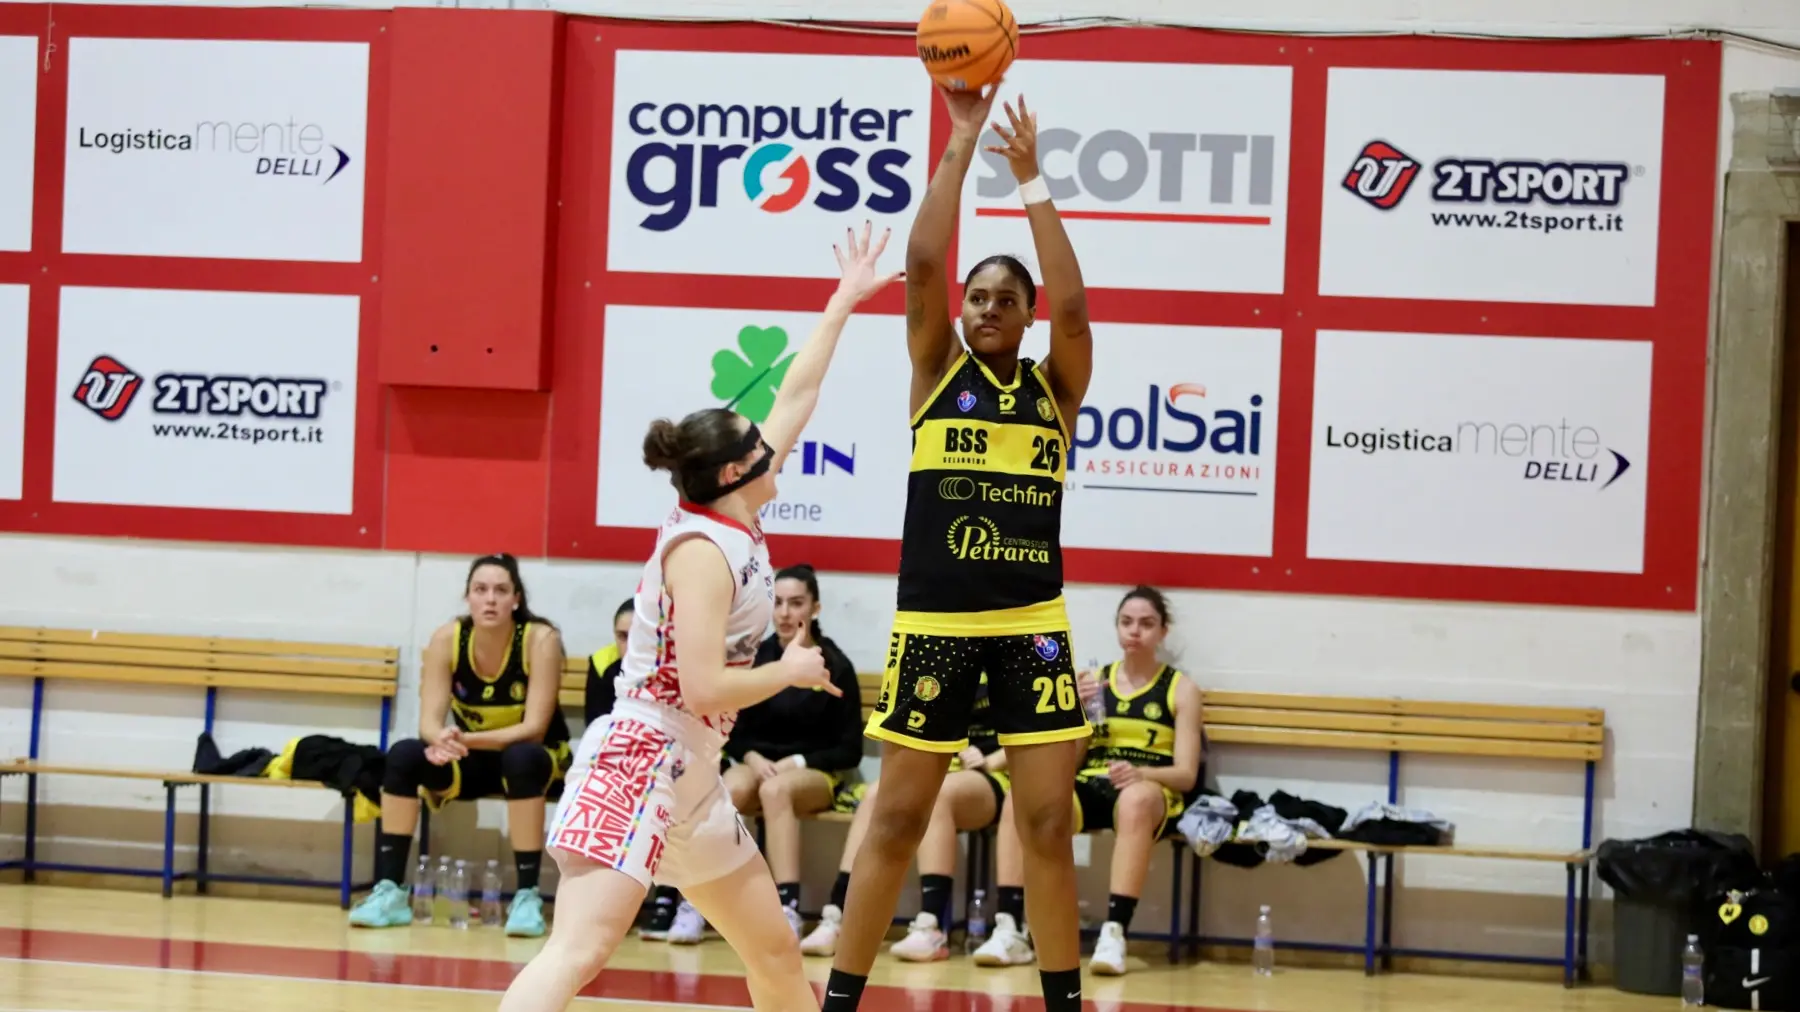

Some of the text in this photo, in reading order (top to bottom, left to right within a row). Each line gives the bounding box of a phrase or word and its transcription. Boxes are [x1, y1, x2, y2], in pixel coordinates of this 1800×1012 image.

[629, 97, 914, 144] computer
[256, 158, 322, 176] DELLI
[976, 127, 1275, 206] SCOTTI
[1494, 161, 1628, 206] SPORT
[626, 142, 912, 232] gross
[1431, 210, 1624, 233] www.2tsport.it
[207, 376, 326, 418] SPORT
[153, 423, 323, 444] www.2tsport.it
[944, 427, 988, 454] BSS
[1066, 382, 1263, 471] polSai
[1030, 435, 1061, 475] 26
[1086, 460, 1260, 480] ASSICURAZIONI
[1524, 461, 1598, 481] DELLI
[978, 482, 1056, 506] Techfin
[956, 526, 1050, 563] Petrarca
[1033, 673, 1076, 714] 26
[1146, 728, 1157, 748] 7
